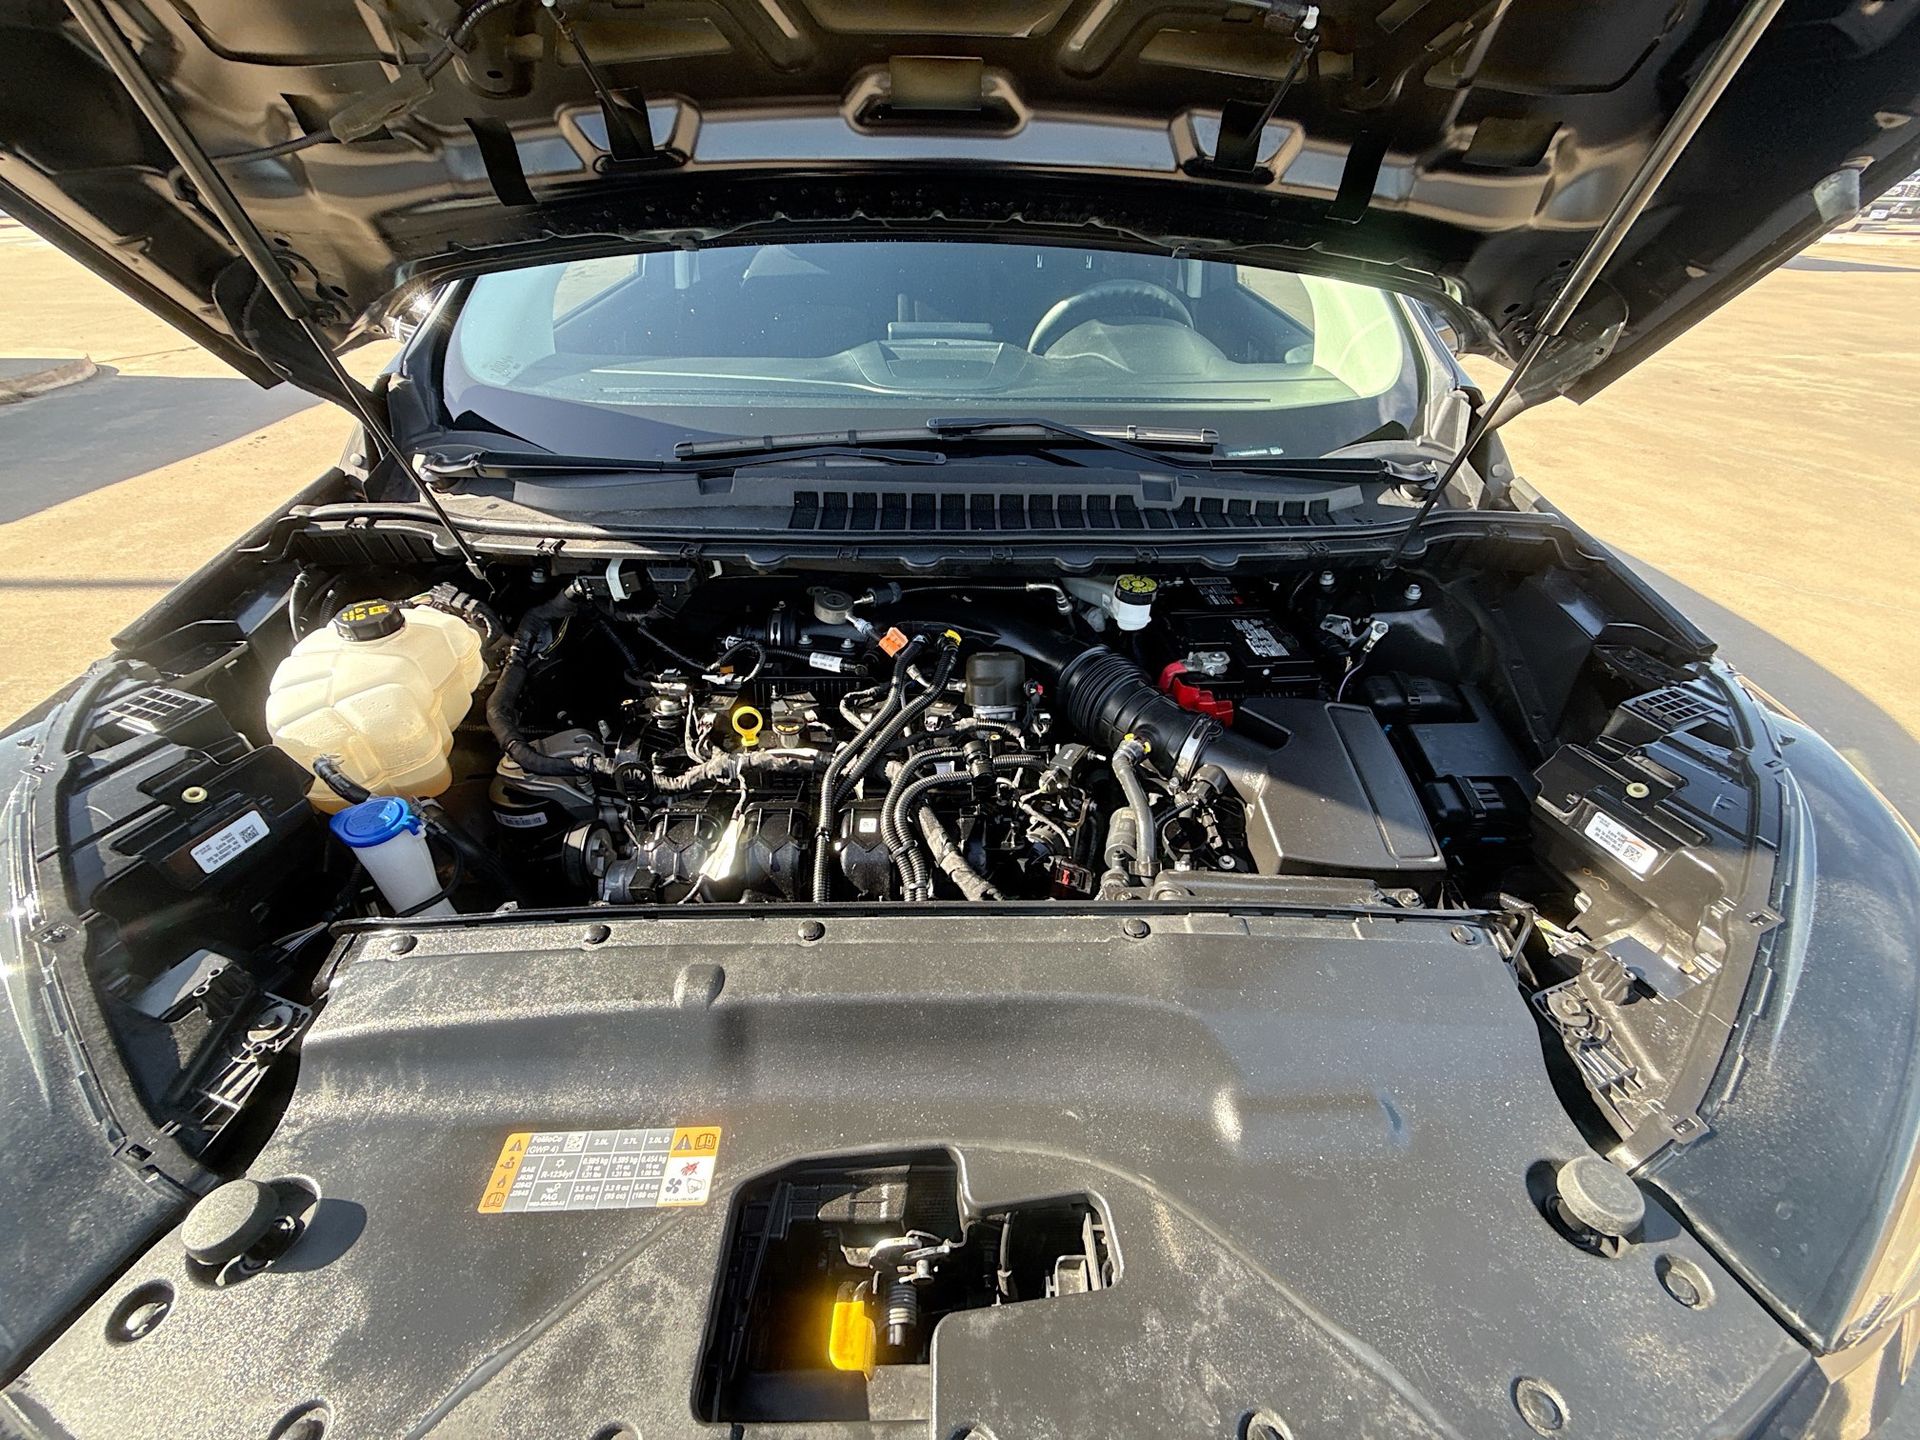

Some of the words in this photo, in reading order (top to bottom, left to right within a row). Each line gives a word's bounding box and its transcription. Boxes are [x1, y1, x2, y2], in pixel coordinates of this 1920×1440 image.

[526, 1145, 550, 1155] (GWP
[550, 1145, 560, 1155] 4)
[540, 1169, 575, 1180] R-1234yf
